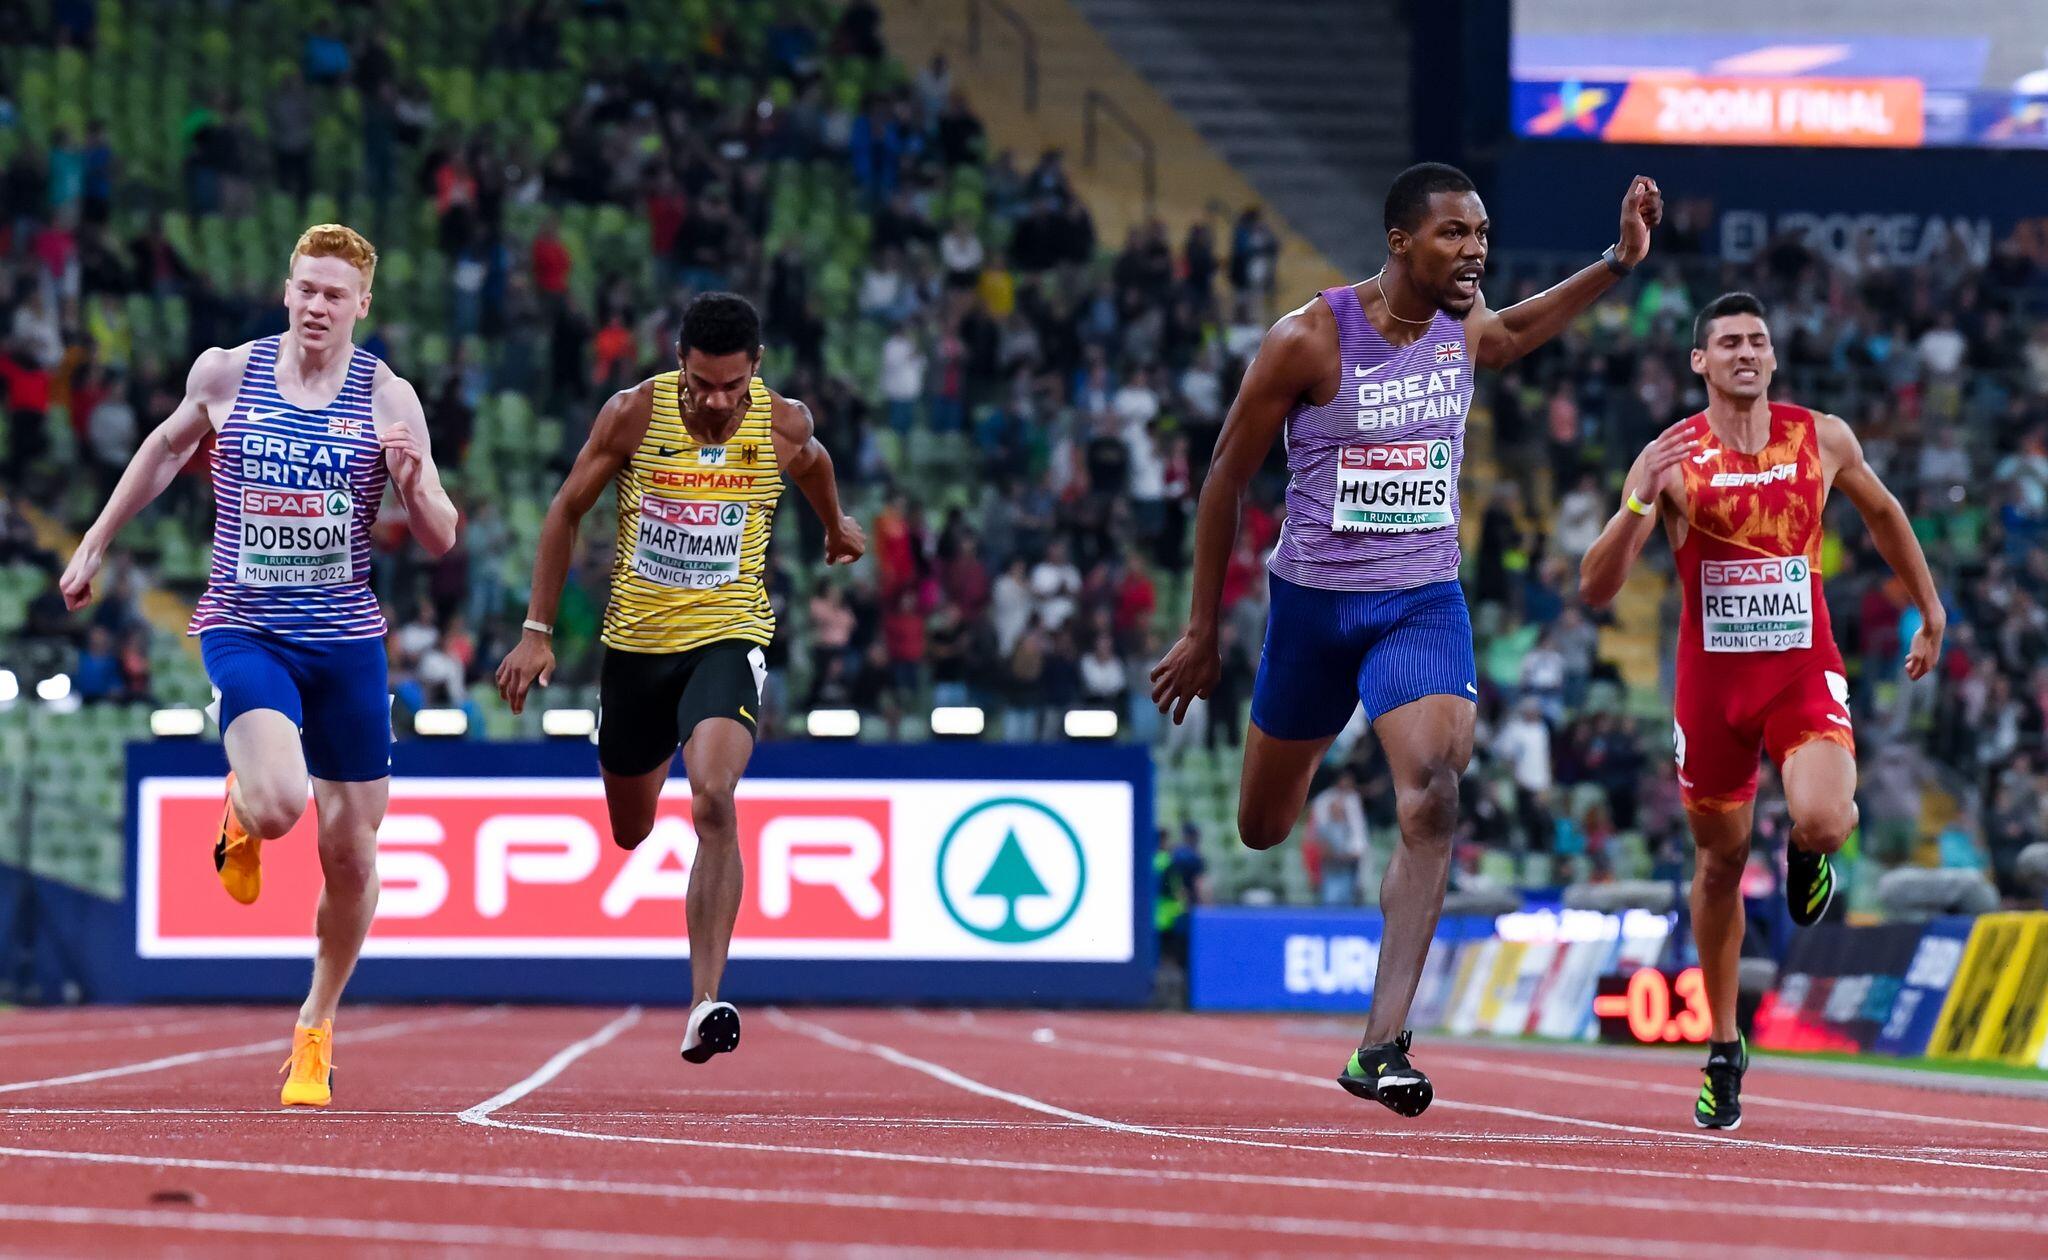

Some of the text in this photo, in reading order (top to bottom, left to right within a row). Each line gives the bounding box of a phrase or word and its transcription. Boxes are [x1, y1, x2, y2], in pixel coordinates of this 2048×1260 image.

[1777, 88, 1894, 135] FINAL
[1358, 368, 1461, 406] GREAT
[1357, 393, 1462, 430] BRITAIN
[242, 434, 355, 469] GREAT
[1344, 447, 1427, 467] SPAR
[242, 458, 351, 490] BRITAIN
[652, 469, 756, 489] GERMANY
[244, 493, 323, 515] SPAR
[1340, 479, 1447, 506] HUGHES
[642, 499, 718, 524] SPAR
[1369, 513, 1392, 522] RUN
[244, 523, 346, 550] DOBSON
[639, 521, 739, 556] HARTMANN
[269, 556, 291, 565] RUN
[638, 559, 693, 585] MUNICH
[660, 556, 682, 568] RUN
[245, 566, 346, 582] MUNICH 2022
[1705, 564, 1781, 584] SPAR
[1706, 592, 1808, 617] RETAMAL
[1733, 623, 1755, 631] RUN
[1757, 622, 1787, 631] CLEAN
[1711, 632, 1805, 647] MUNICH 2022
[1593, 968, 1711, 1043] -0.3
